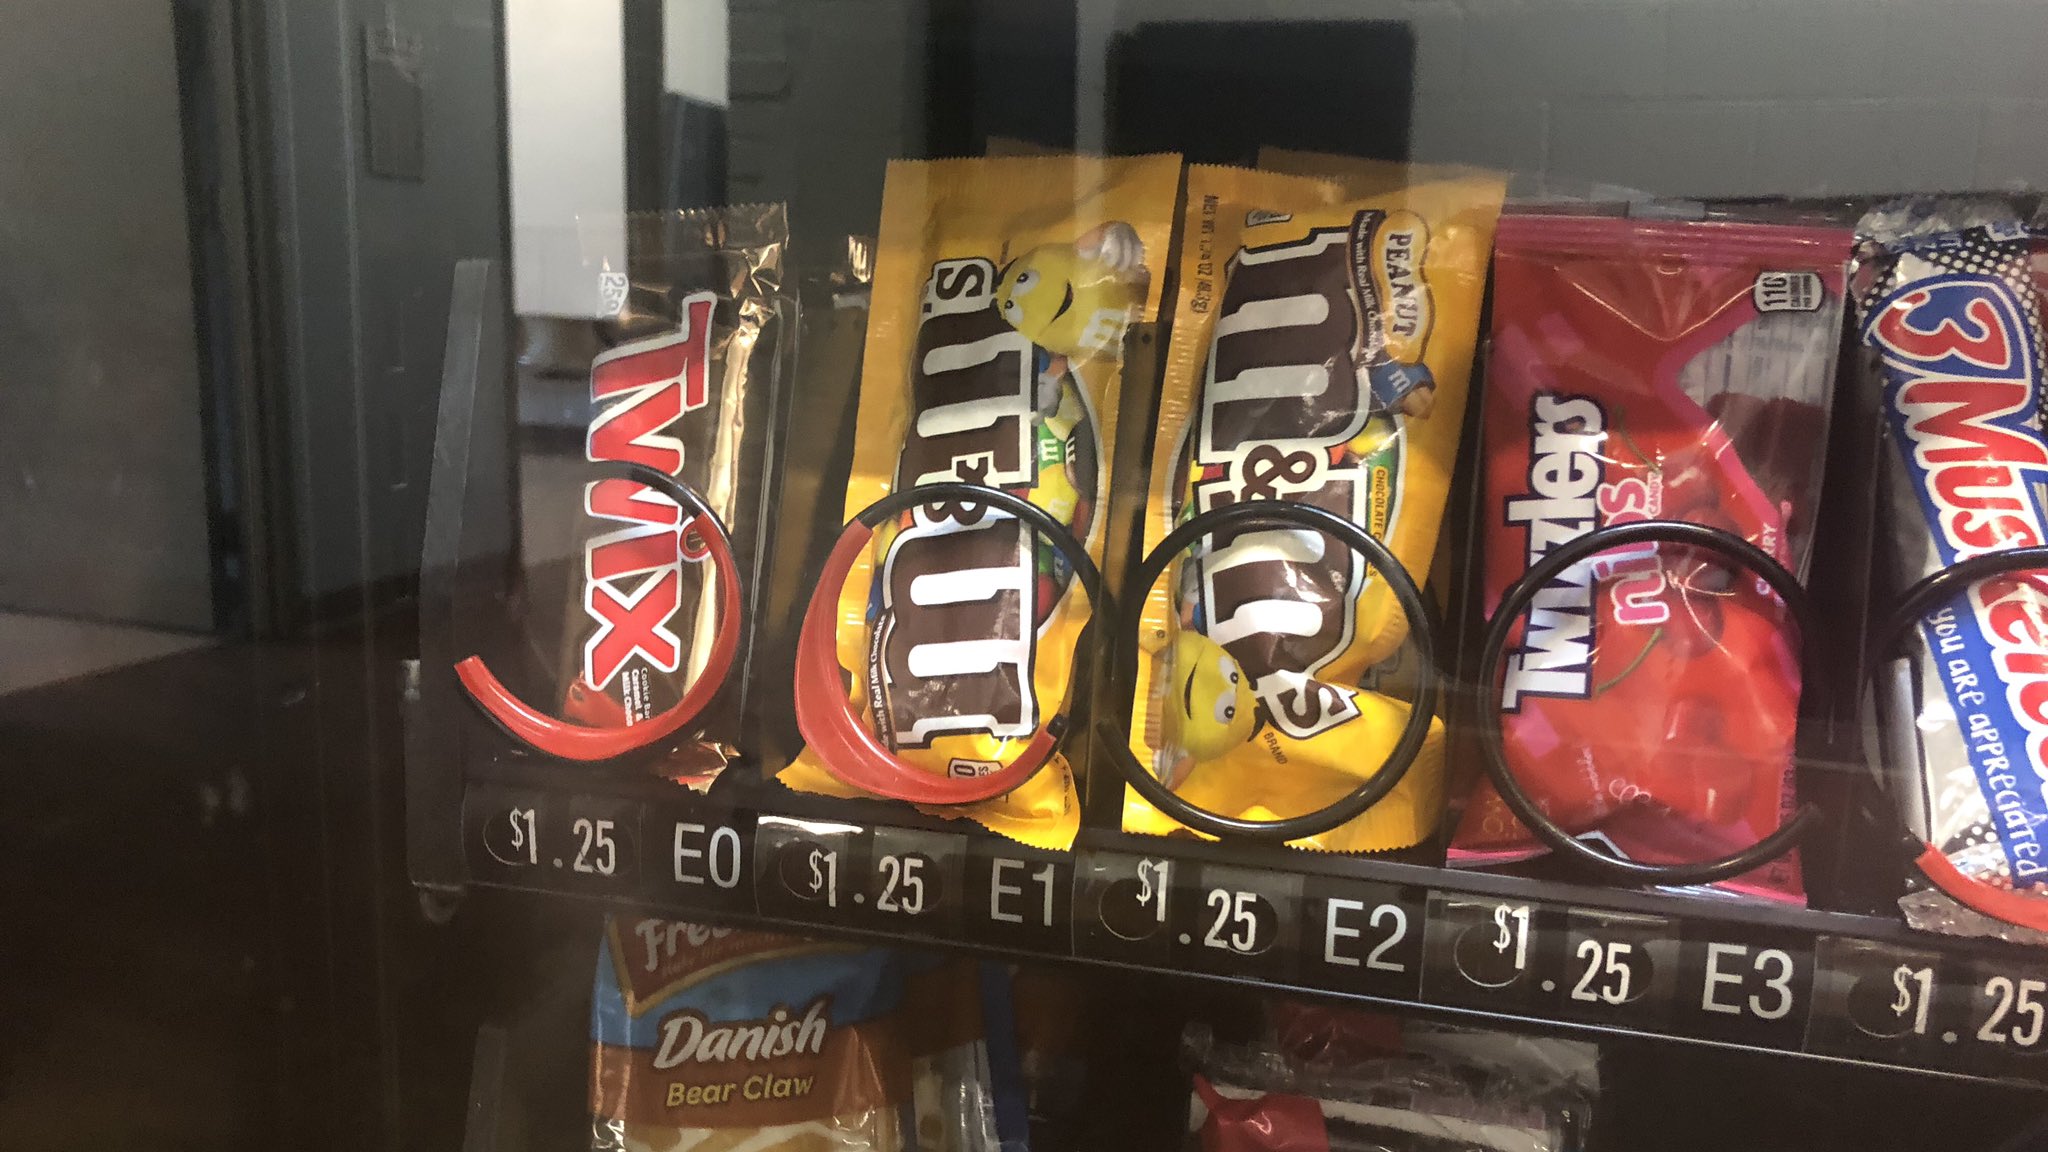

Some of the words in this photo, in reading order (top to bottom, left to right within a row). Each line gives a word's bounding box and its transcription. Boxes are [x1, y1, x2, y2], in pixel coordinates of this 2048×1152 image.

[1386, 233, 1419, 337] PEANUT
[1876, 291, 2010, 370] 3
[1374, 469, 1386, 529] CHOCOLATE
[870, 614, 886, 662] Chocolate
[1927, 606, 1965, 655] you
[622, 671, 631, 696] Milk
[631, 669, 643, 711] Caramel
[641, 667, 650, 702] Cookie
[870, 664, 880, 684] Milk
[871, 685, 883, 708] Real
[1264, 731, 1288, 765] BRAND
[673, 822, 741, 889] E0
[990, 857, 1055, 927] E1
[1324, 897, 1408, 972] E2
[1701, 942, 1796, 1020] E3
[653, 1001, 828, 1070] Danish
[666, 1081, 735, 1107] Bear
[743, 1074, 814, 1100] Claw
